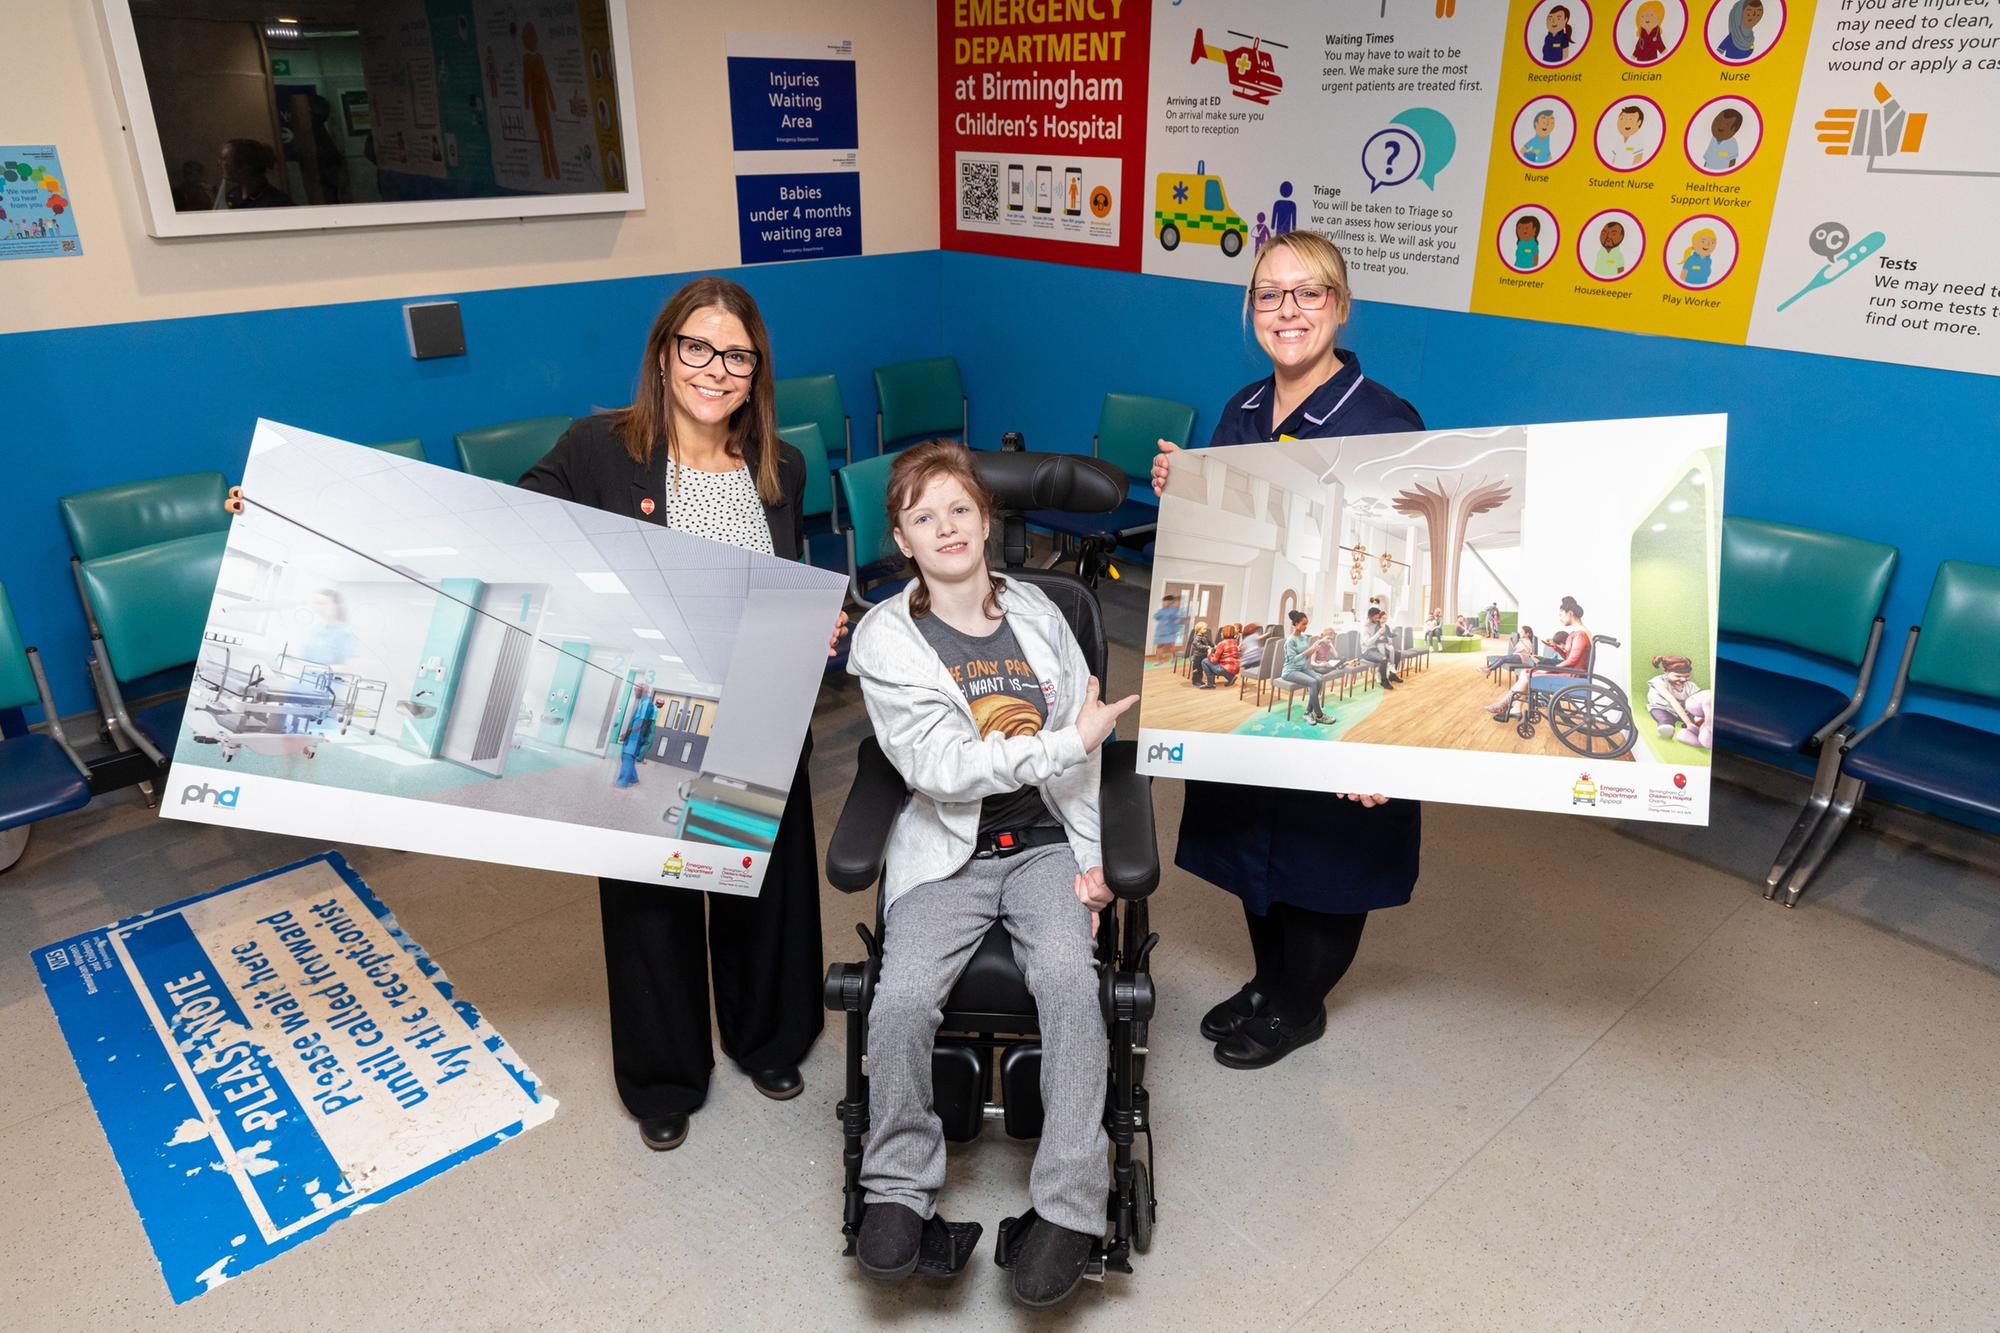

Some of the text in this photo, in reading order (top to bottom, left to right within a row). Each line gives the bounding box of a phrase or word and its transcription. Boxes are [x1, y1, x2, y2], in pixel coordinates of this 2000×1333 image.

[954, 0, 1123, 27] EMERGENCY
[1841, 0, 1853, 10] If
[1856, 0, 1887, 14] you
[1892, 0, 1919, 8] are
[1836, 13, 1993, 34] may need to clean,
[955, 31, 1126, 64] DEPARTMENT
[1325, 33, 1395, 47] Waiting Times
[1832, 35, 2000, 53] close and dress your
[1324, 46, 1461, 63] You may have to wait to be
[1322, 63, 1468, 76] seen. We make sure the most
[1828, 56, 1972, 74] wound or apply a
[770, 71, 820, 90] Injuries
[1527, 72, 1582, 83] Receptionist
[1621, 72, 1662, 82] Clinician
[1720, 71, 1751, 81] Nurse
[955, 69, 1123, 109] at Birmingham
[1321, 79, 1483, 94] urgent patients are treated first.
[768, 93, 822, 111] Waiting
[1166, 96, 1221, 108] Arriving at ED
[781, 114, 813, 128] Area
[1166, 110, 1265, 123] On arrival make sure you
[1043, 114, 1123, 145] Hospital
[1165, 125, 1240, 136] report to reception
[1385, 140, 1400, 175] ?
[1524, 173, 1550, 183] Nurse
[1589, 177, 1654, 190] Student Nurse
[780, 185, 822, 200] Babies
[1313, 185, 1341, 198] Triage
[1685, 182, 1741, 194] Healthcare
[1670, 194, 1752, 208] Support Worker
[750, 203, 852, 222] under 4 months
[1312, 200, 1453, 220] You will be taken to Triage so
[761, 226, 842, 242] waiting area
[1311, 215, 1458, 236] we can assess how serious your
[1379, 233, 1396, 244] We
[1398, 234, 1416, 246] will
[1418, 236, 1434, 248] ask
[1437, 239, 1456, 251] you
[1353, 247, 1364, 256] to
[1366, 246, 1387, 259] help
[1389, 250, 1400, 260] us
[1402, 250, 1460, 265] understand
[1880, 256, 1918, 271] Tests
[1351, 261, 1361, 270] to
[1363, 261, 1386, 273] treat
[1388, 266, 1409, 277] you.
[1499, 276, 1545, 290] Interpreter
[1875, 274, 2000, 298] We may need t
[1574, 285, 1633, 300] Housekeeper
[1662, 293, 1721, 309] Play Worker
[1869, 296, 1987, 317] run some tests
[1866, 311, 1981, 336] find out more.
[966, 659, 1000, 679] ONLY
[969, 677, 1023, 697] WANT IS
[1147, 742, 1184, 763] phd
[181, 782, 240, 807] phd
[1600, 785, 1635, 794] Emergency
[1600, 790, 1637, 800] Department
[1600, 797, 1622, 805] Appeal
[46, 949, 69, 970] NHS
[308, 898, 473, 1086] by the receptionist
[255, 910, 429, 1110] until called forward
[231, 940, 364, 1115] Please wait here
[164, 970, 288, 1133] PLEASE NOTE
